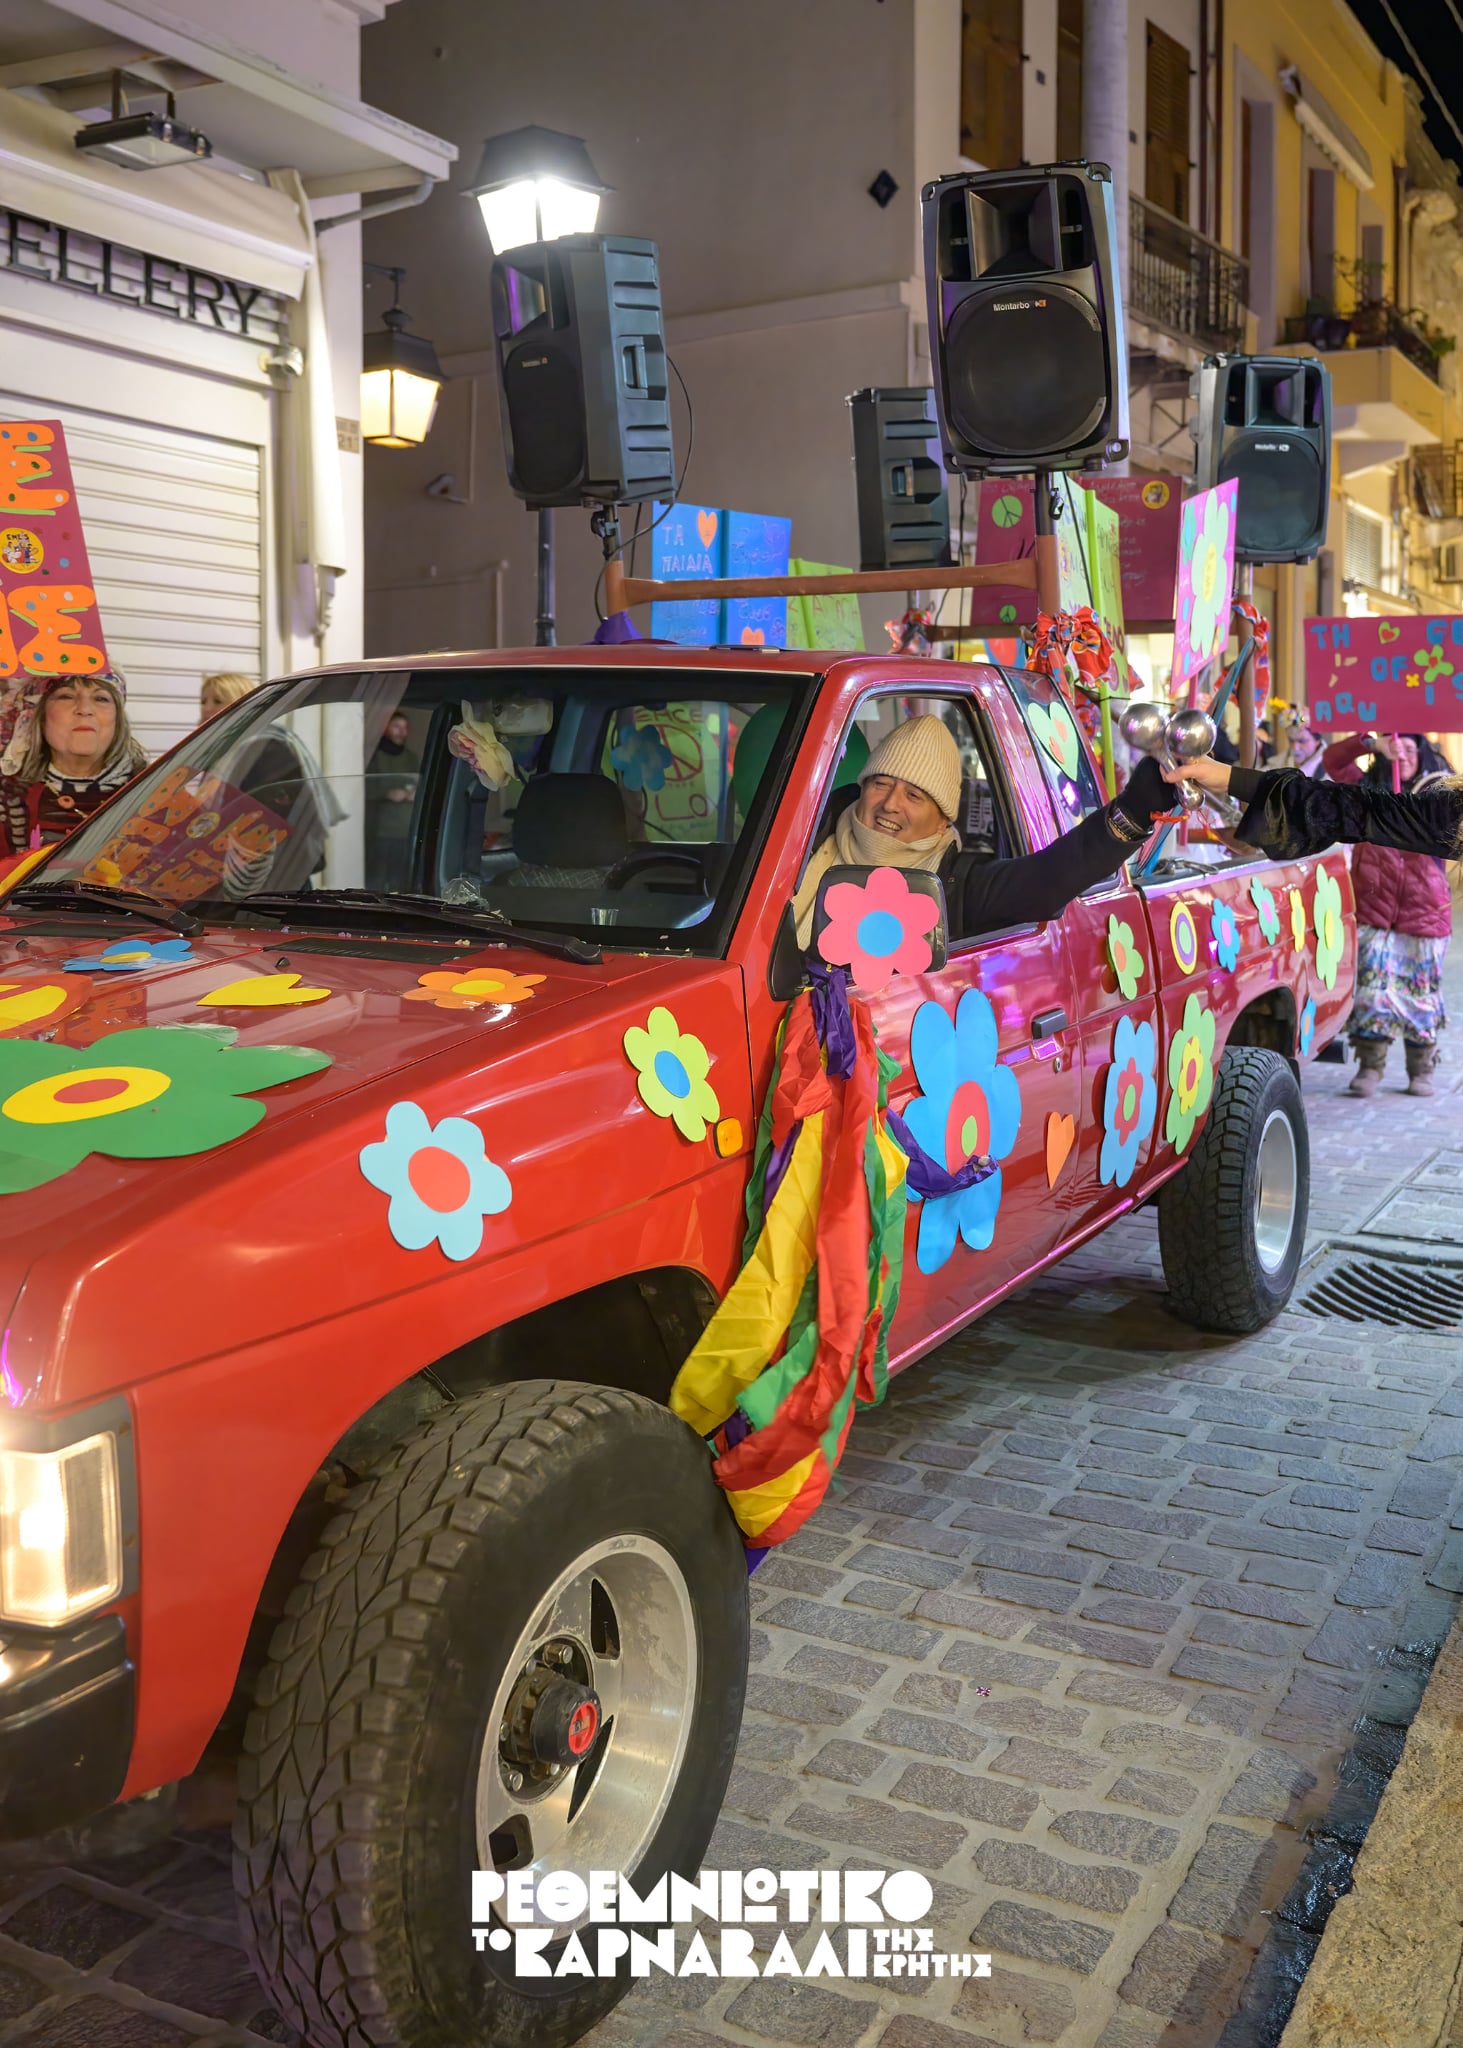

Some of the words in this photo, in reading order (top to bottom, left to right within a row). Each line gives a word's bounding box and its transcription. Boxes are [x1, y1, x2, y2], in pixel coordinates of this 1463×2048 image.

[993, 301, 1030, 312] Montarbo
[1311, 623, 1351, 649] TH
[1370, 656, 1409, 682] OF
[1315, 692, 1377, 722] AQU
